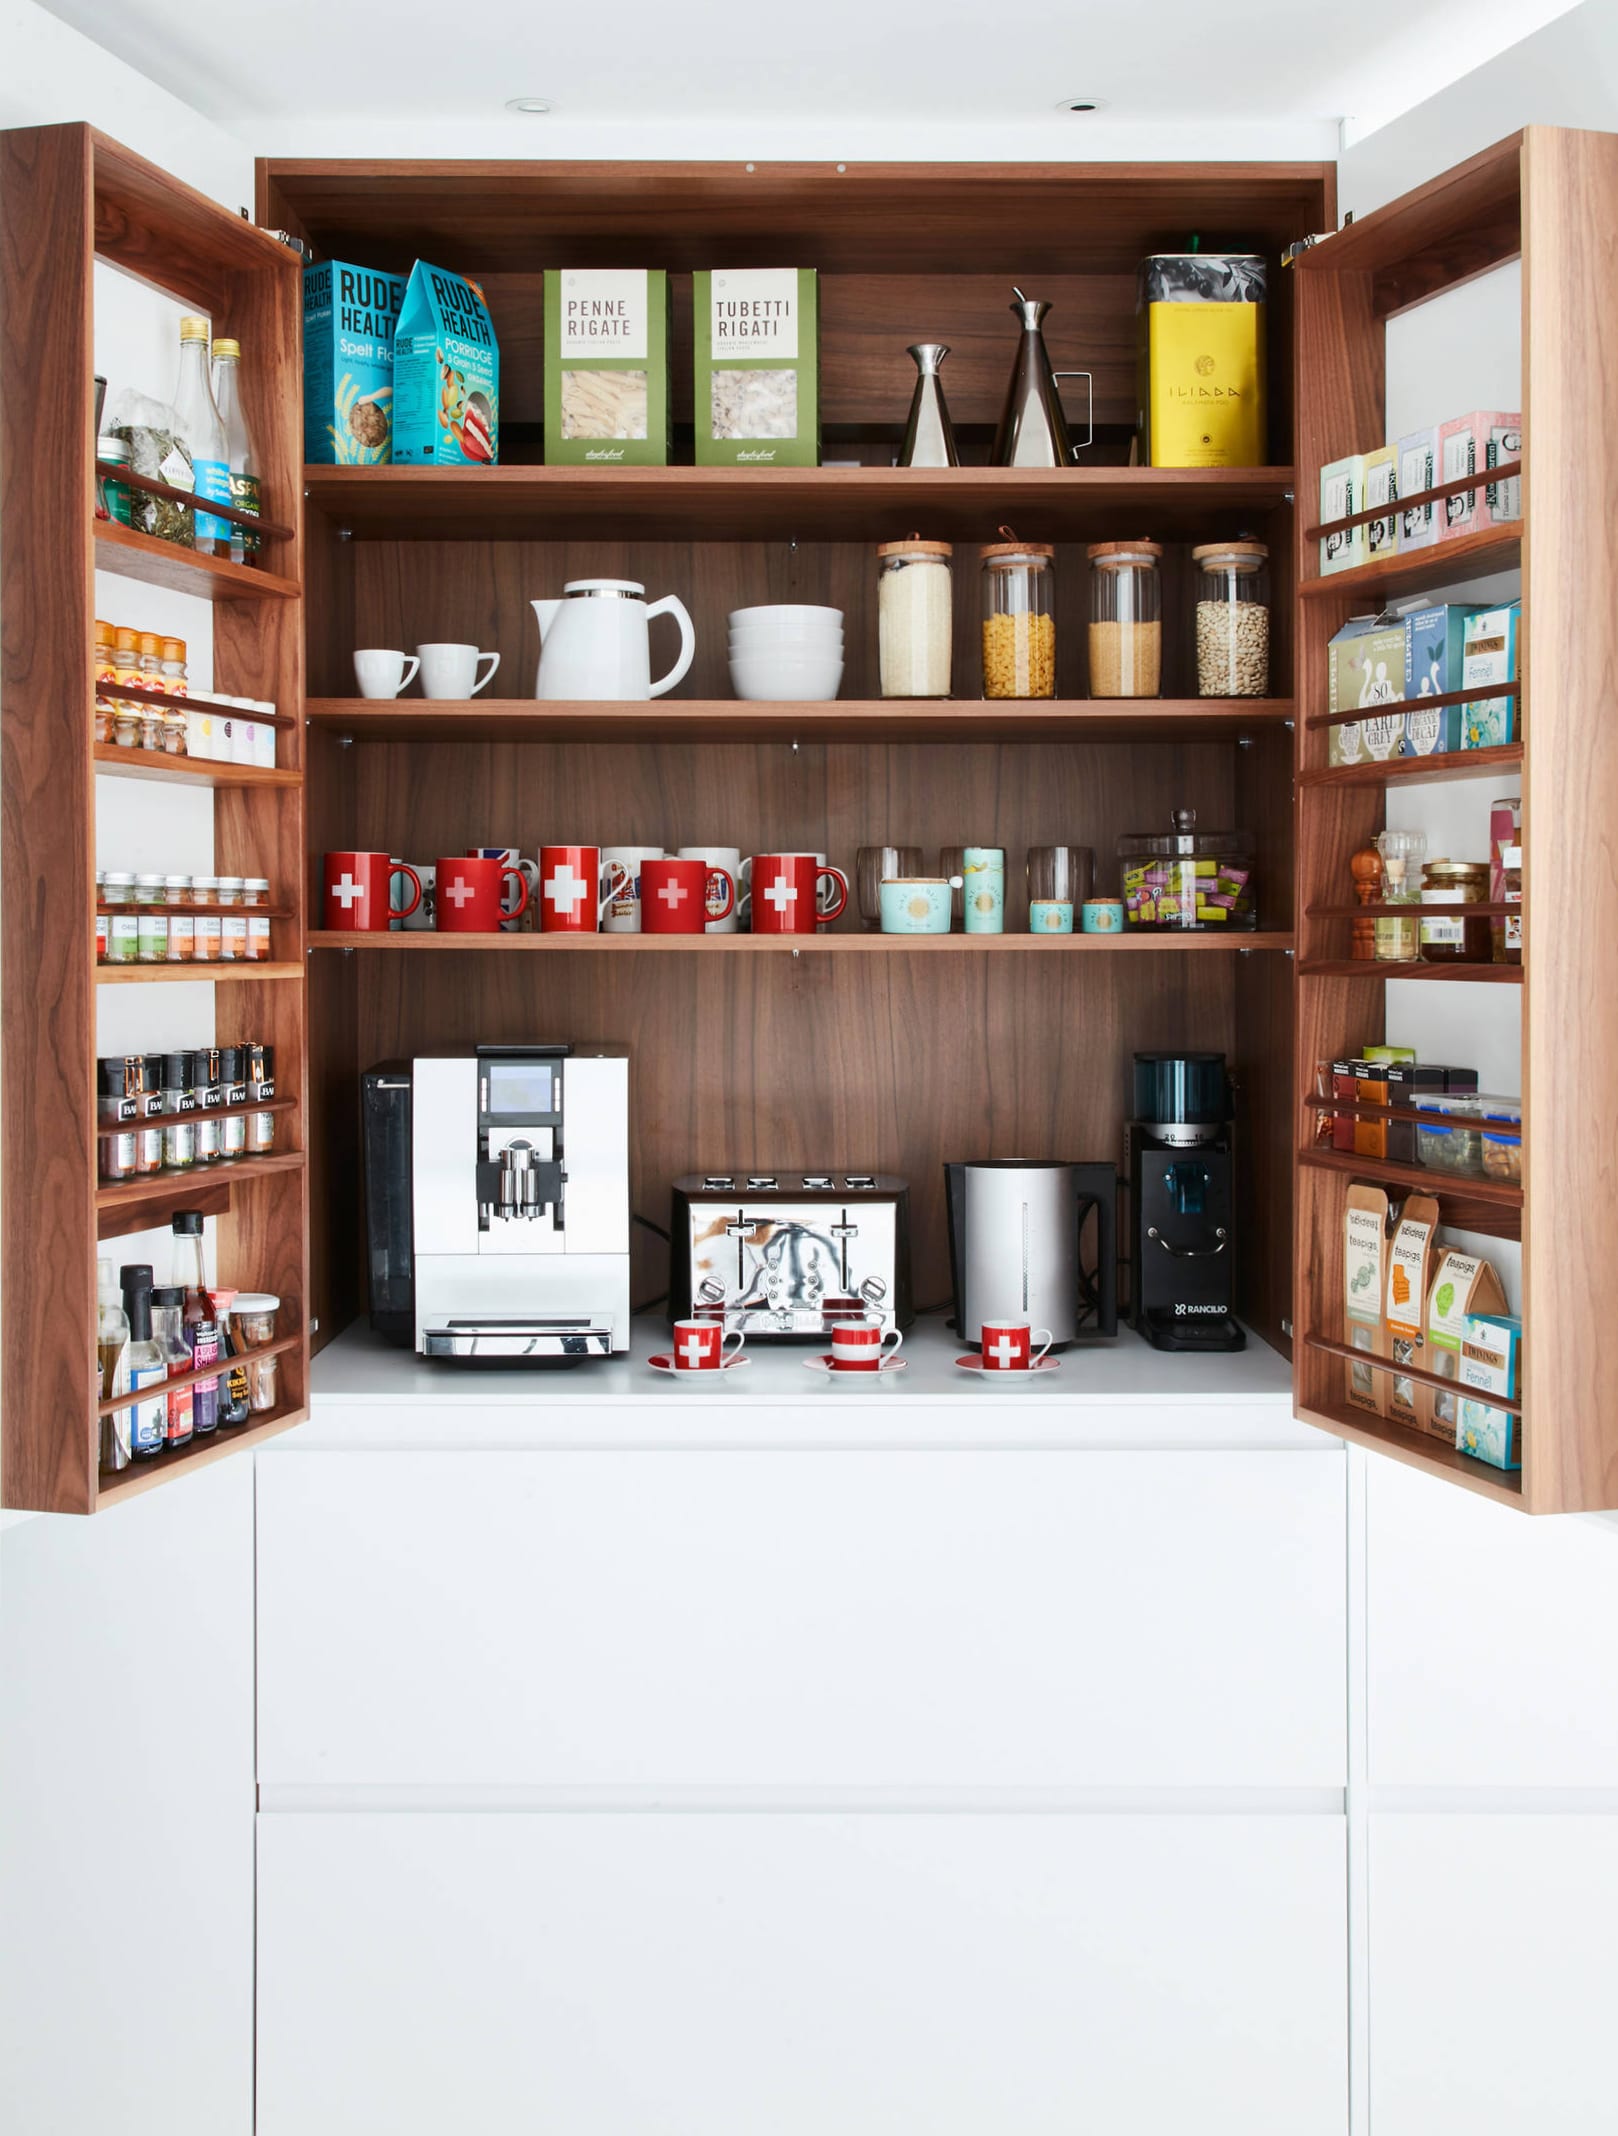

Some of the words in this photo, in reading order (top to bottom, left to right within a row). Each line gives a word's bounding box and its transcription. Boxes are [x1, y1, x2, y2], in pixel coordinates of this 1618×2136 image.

[341, 269, 401, 314] RUDE
[431, 273, 485, 320] RUDE
[568, 300, 626, 317] PENNE
[716, 300, 789, 318] TUBETTI
[440, 308, 491, 346] HEALTH
[568, 319, 630, 336] RIGATE
[719, 320, 777, 337] RIGATI
[340, 338, 373, 358] Spelt
[445, 338, 492, 365] PORRIDGE
[1169, 386, 1241, 397] ILIADA
[1373, 682, 1388, 700] SO
[1368, 730, 1392, 746] GREY
[1187, 1305, 1228, 1314] RANCILIO
[1466, 1368, 1492, 1389] Fennel
